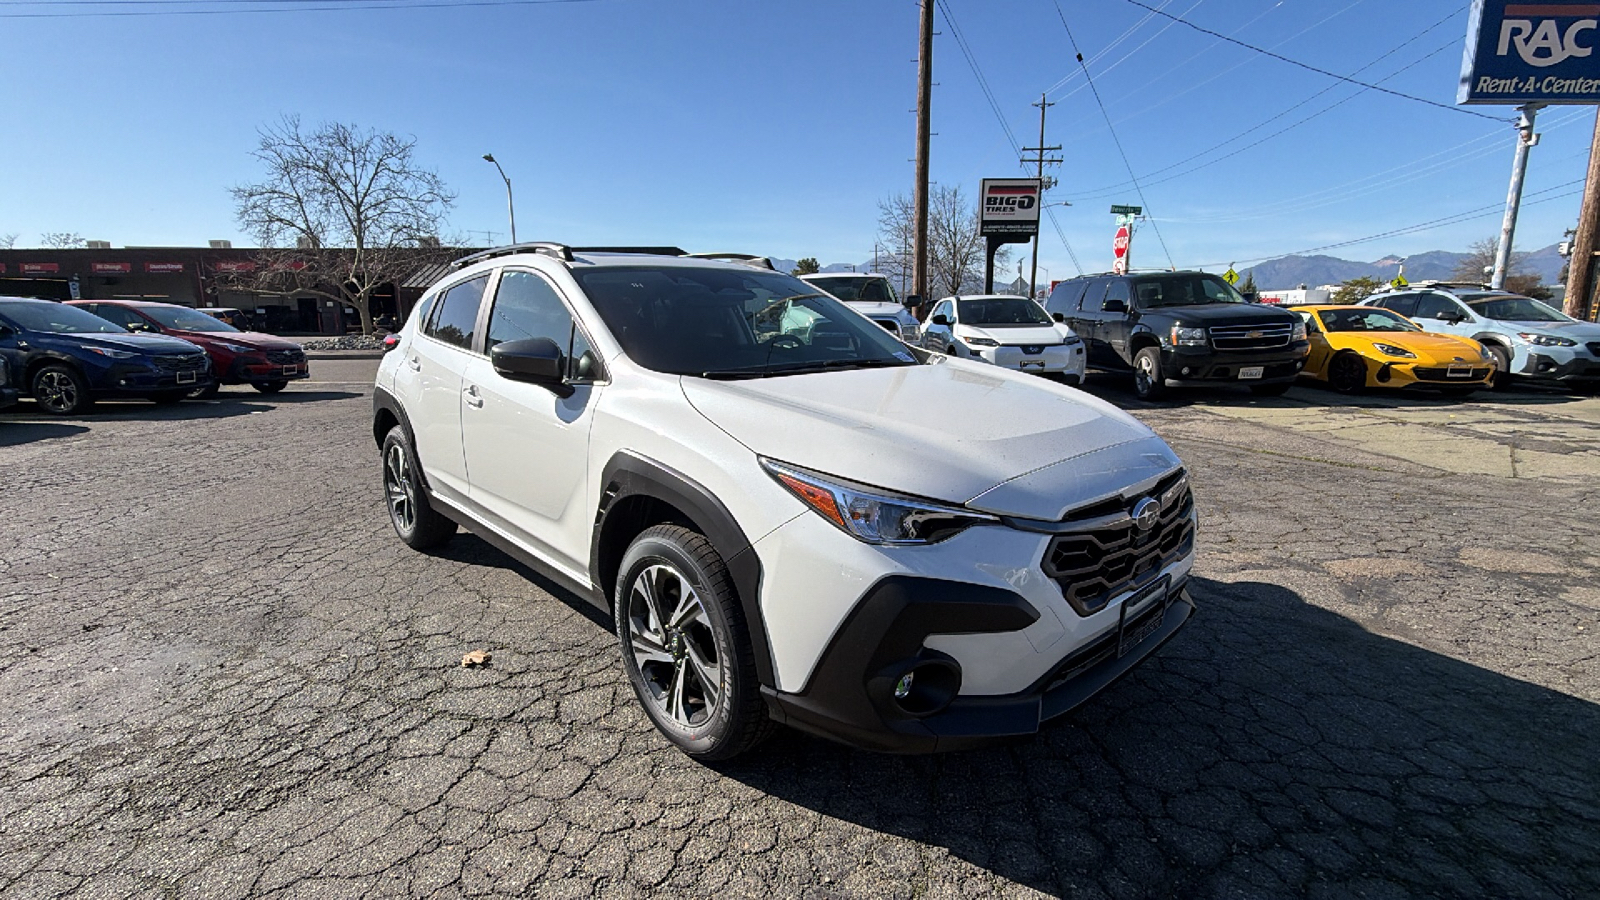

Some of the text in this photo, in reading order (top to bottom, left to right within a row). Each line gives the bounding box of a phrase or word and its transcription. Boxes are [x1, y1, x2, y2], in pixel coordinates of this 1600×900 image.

[1496, 19, 1598, 67] RAC
[986, 196, 1018, 206] BIG
[1114, 236, 1129, 249] STOP
